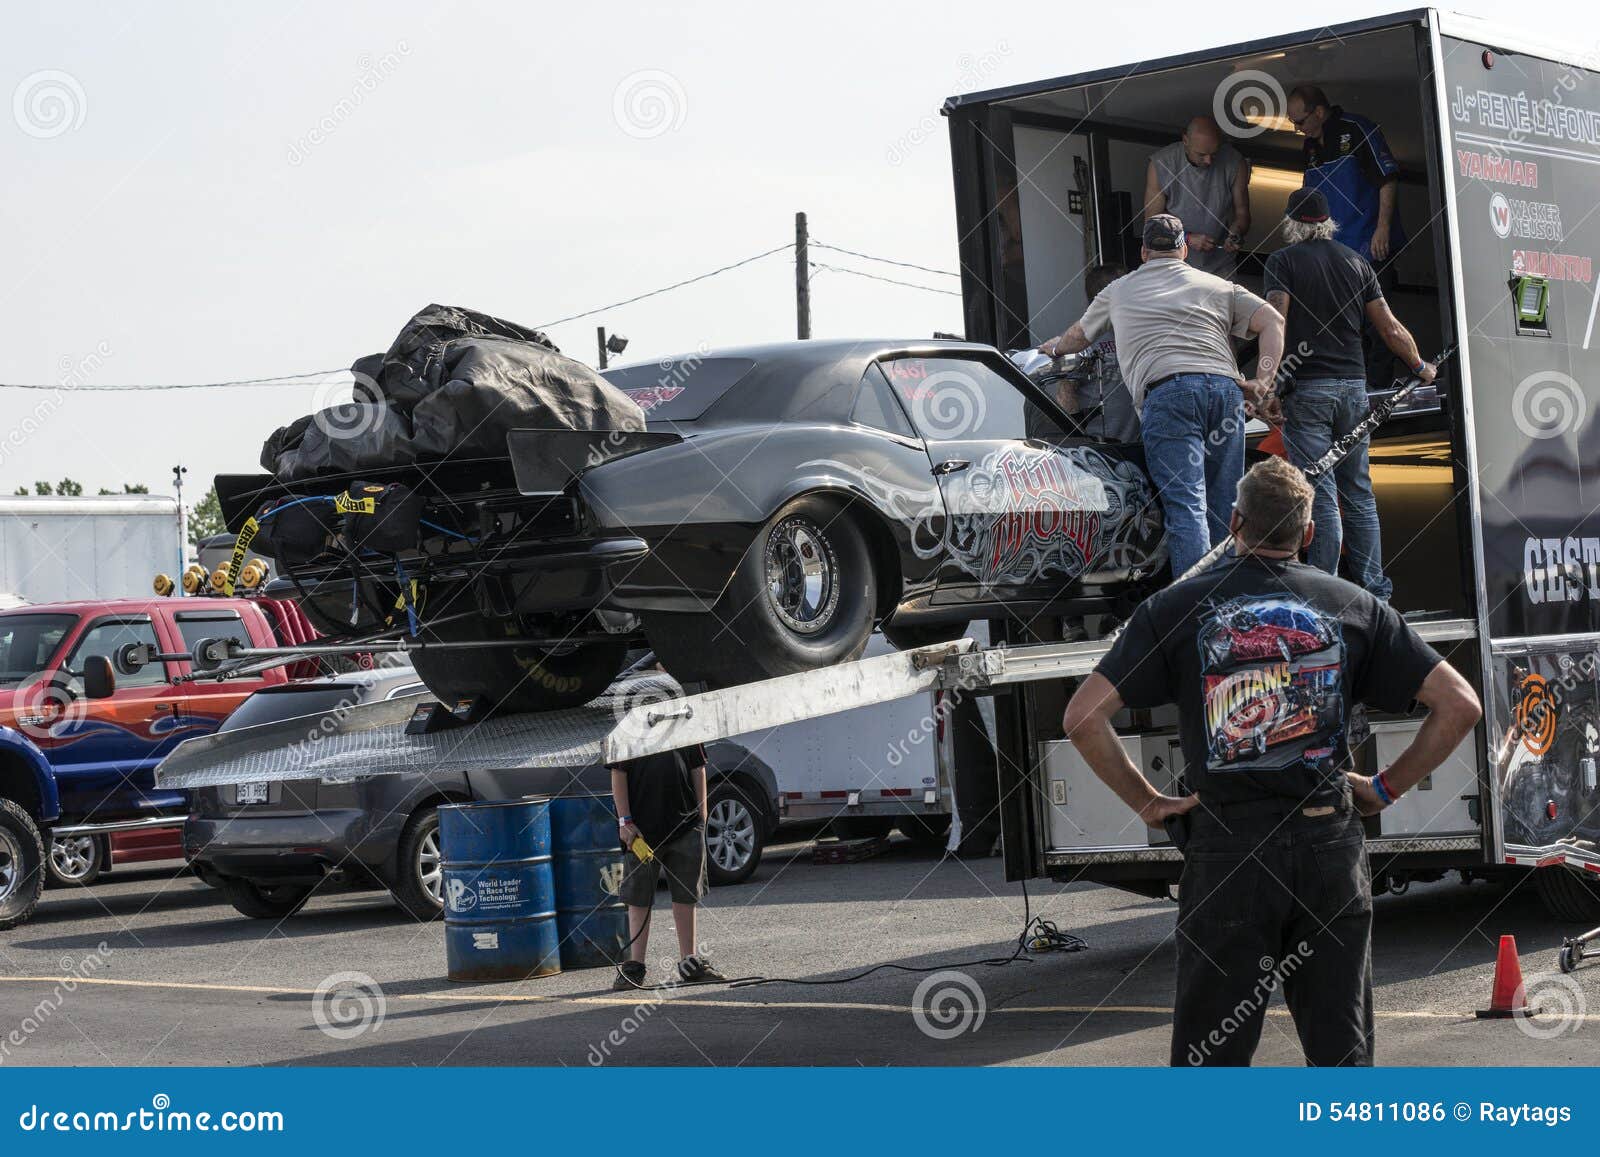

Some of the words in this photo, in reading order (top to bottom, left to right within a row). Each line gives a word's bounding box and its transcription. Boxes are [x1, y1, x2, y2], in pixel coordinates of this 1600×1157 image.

[1457, 150, 1538, 188] YANMAR
[1509, 199, 1561, 223] WACKER
[1512, 220, 1564, 241] NEUSON
[1525, 251, 1592, 282] MANITOU
[237, 525, 255, 552] DEIST
[227, 552, 244, 587] SAFETY
[1524, 537, 1600, 604] GEST
[478, 880, 498, 888] World
[499, 879, 521, 888] Leader
[486, 887, 503, 895] Race
[504, 886, 519, 894] Fuel
